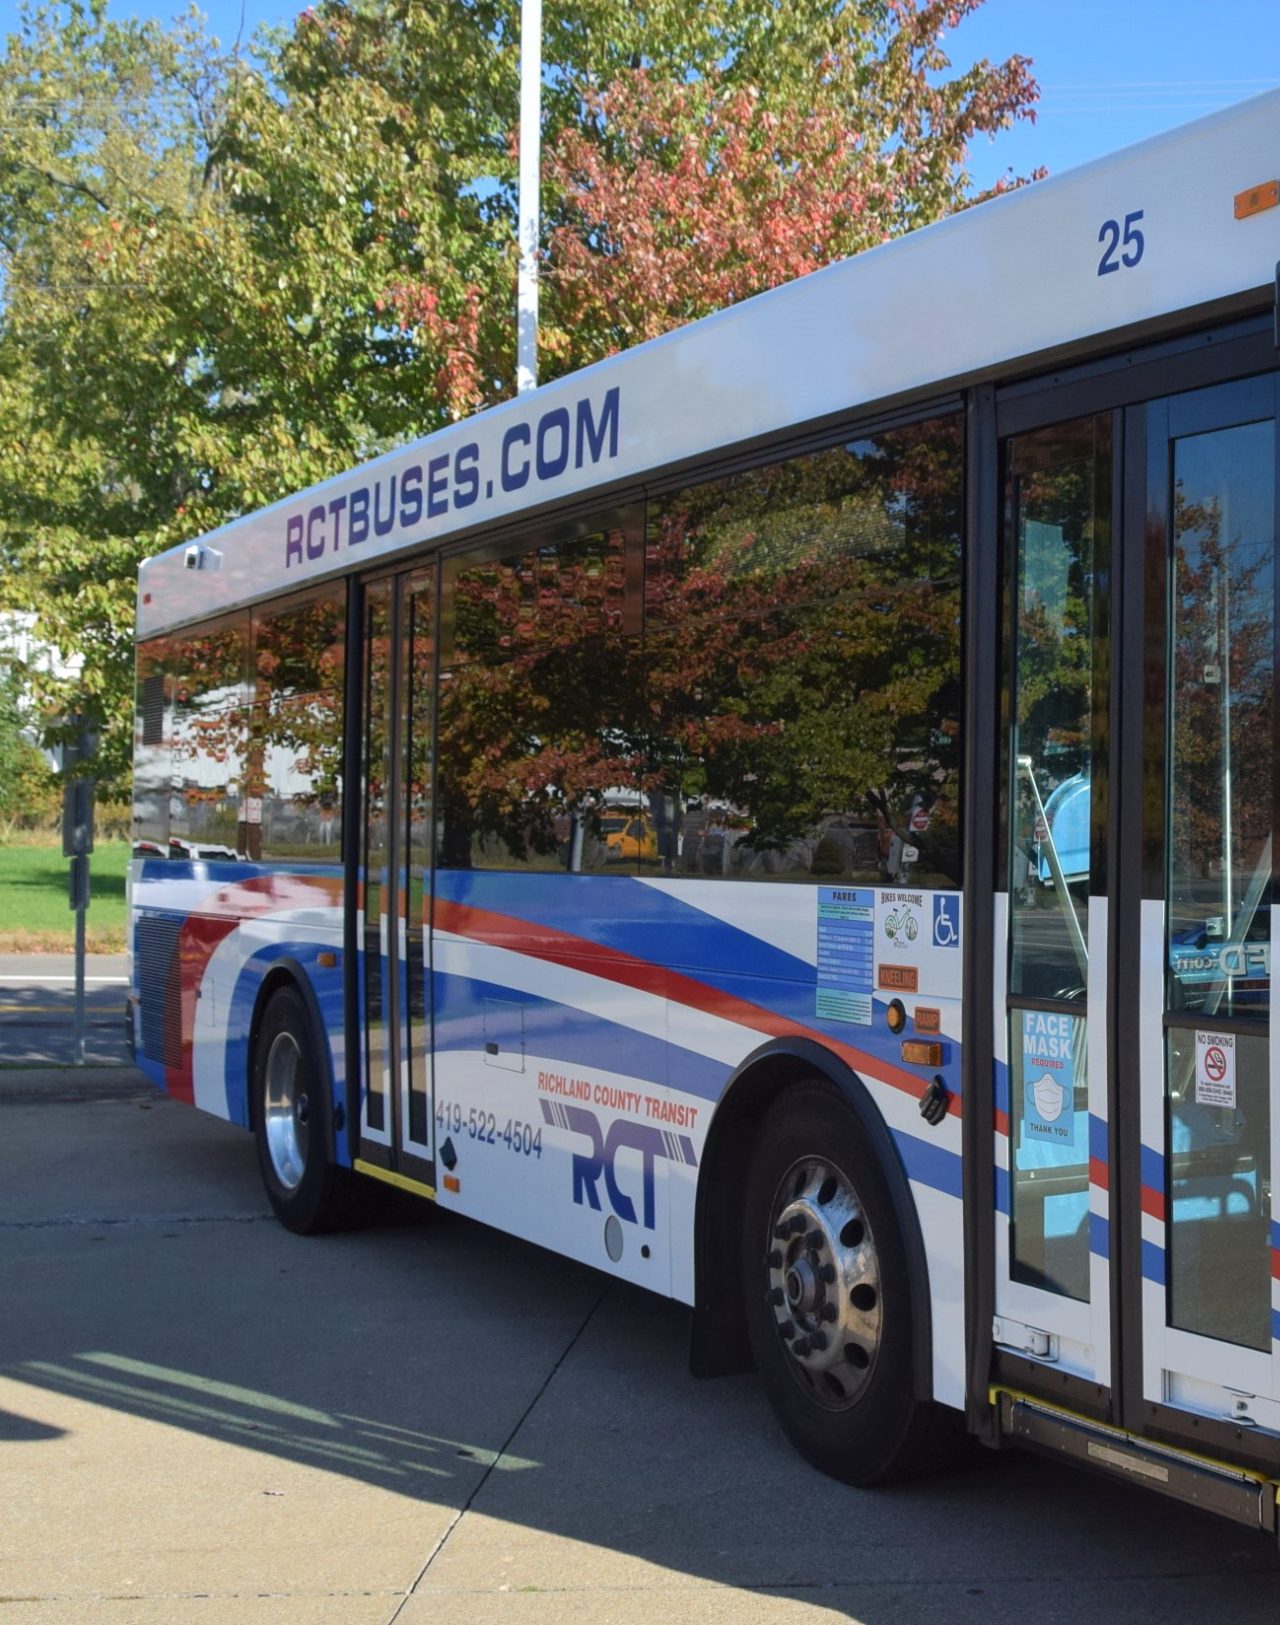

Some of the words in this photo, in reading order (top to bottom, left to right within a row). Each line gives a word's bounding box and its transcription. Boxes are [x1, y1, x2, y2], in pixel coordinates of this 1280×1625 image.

[1098, 209, 1145, 277] 25
[286, 387, 621, 568] RCTBUSES.COM
[832, 891, 857, 902] FARES
[881, 892, 896, 904] BIKES
[897, 893, 922, 907] WELCOME
[880, 967, 915, 988] KNEELING
[917, 1011, 938, 1027] RAMP
[1026, 1013, 1069, 1038] FACE
[1023, 1034, 1072, 1060] MASK
[1198, 1034, 1206, 1045] NO
[1207, 1036, 1233, 1048] SMOKING
[1031, 1057, 1064, 1070] REQUIRED
[538, 1072, 591, 1101] RICHLAND
[593, 1084, 642, 1112] COUNTY
[644, 1096, 698, 1129] TRANSIT
[436, 1100, 543, 1159] 419-522-4504
[1030, 1122, 1053, 1135] THANK
[1054, 1127, 1068, 1137] YOU
[562, 1102, 670, 1231] RCT
